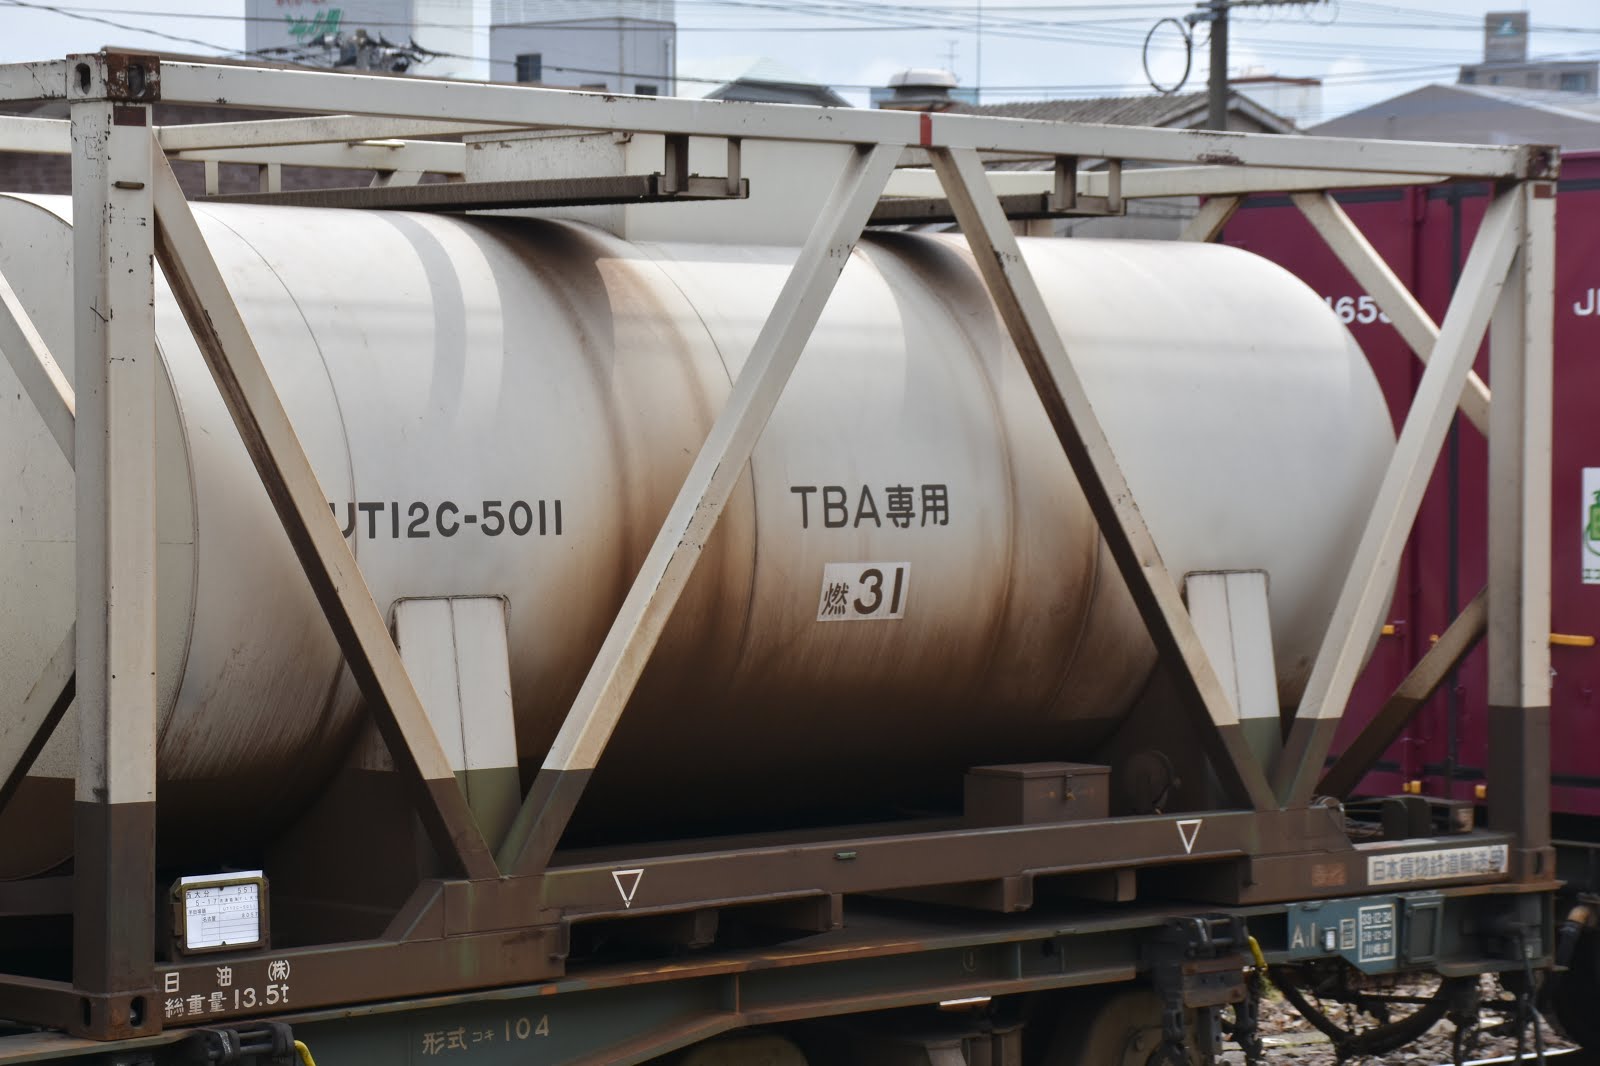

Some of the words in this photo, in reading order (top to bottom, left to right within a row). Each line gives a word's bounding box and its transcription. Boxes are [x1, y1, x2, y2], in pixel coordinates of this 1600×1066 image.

[1573, 287, 1600, 316] J
[790, 484, 949, 529] TBA専用
[505, 1014, 550, 1042] 104
